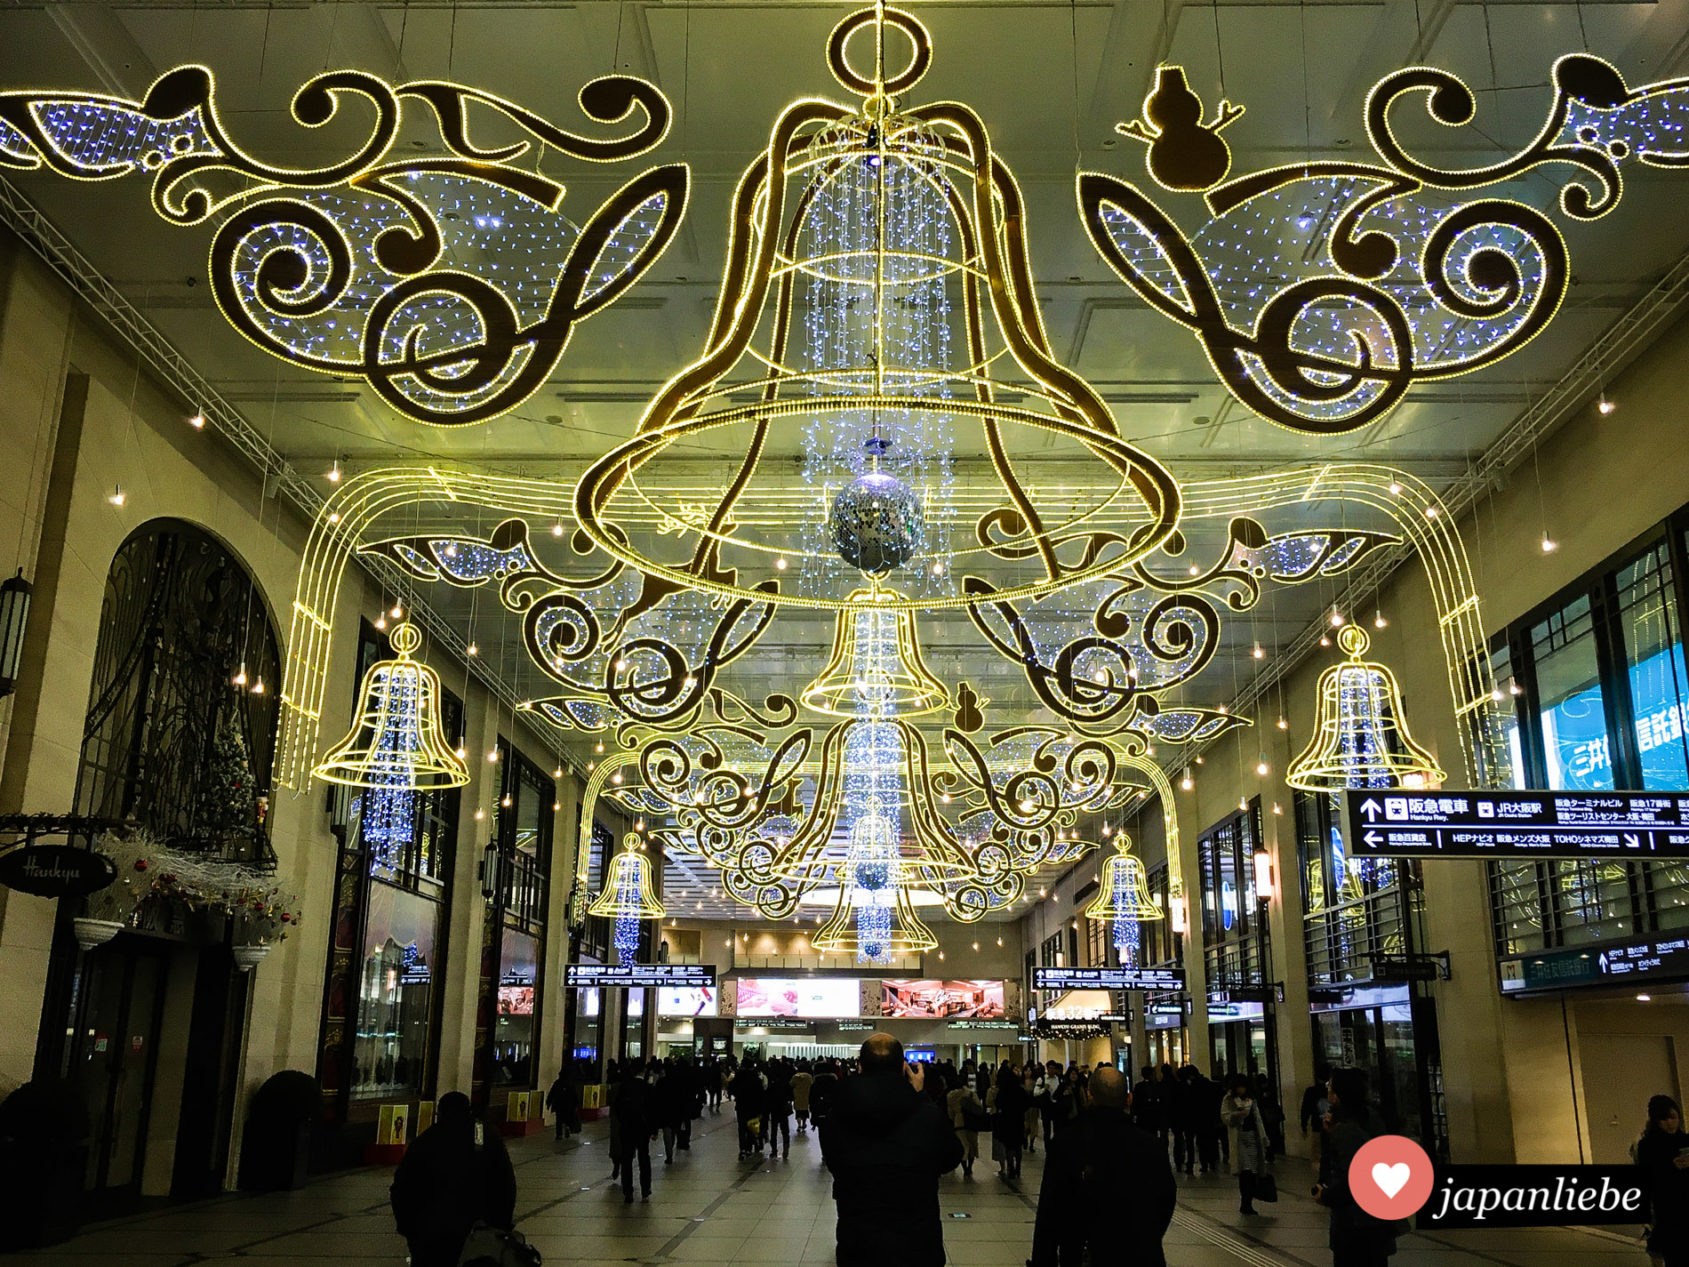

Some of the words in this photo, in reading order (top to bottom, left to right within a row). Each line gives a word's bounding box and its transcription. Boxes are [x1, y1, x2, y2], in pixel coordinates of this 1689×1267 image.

[1408, 798, 1469, 814] 阪急電車
[1554, 798, 1623, 808] 阪急ターミナルビル
[1497, 802, 1543, 814] JR大阪駅
[1410, 814, 1433, 822] Hankyu
[1556, 812, 1625, 821] 阪急ツーリストセンター
[1388, 833, 1427, 842] 阪急百貨店
[1452, 833, 1494, 843] HEPナビオ
[1496, 834, 1551, 843] 阪急メンズ大阪
[1553, 835, 1620, 844] TOHOシネマズ梅田
[23, 855, 80, 885] Hankyu
